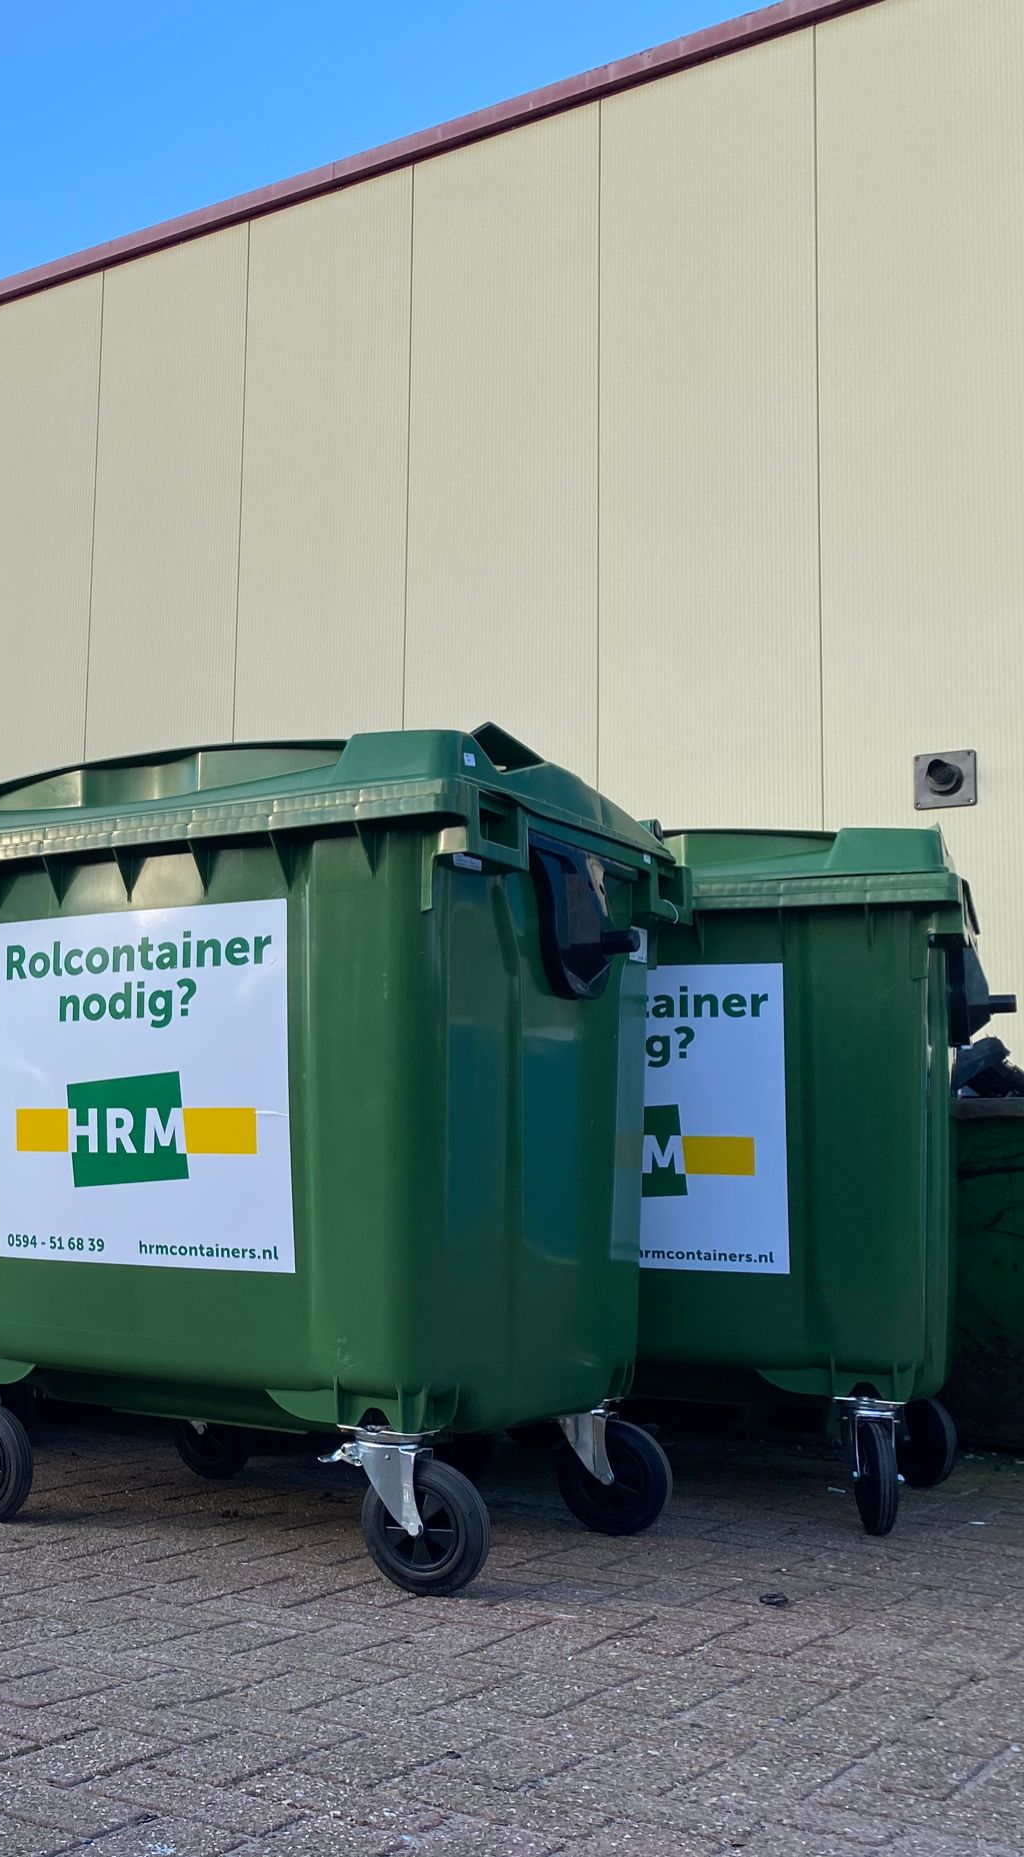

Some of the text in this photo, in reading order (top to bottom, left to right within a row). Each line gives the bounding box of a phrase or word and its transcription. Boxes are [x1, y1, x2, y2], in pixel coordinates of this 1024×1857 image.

[6, 930, 272, 981] Rolcontainer
[59, 978, 197, 1029] nodig?
[68, 1107, 187, 1154] HRM
[7, 1233, 38, 1249] 0594
[49, 1236, 65, 1250] 51
[67, 1237, 84, 1251] 68
[88, 1237, 105, 1252] 39
[138, 1240, 279, 1260] hrmcontainers.nl
